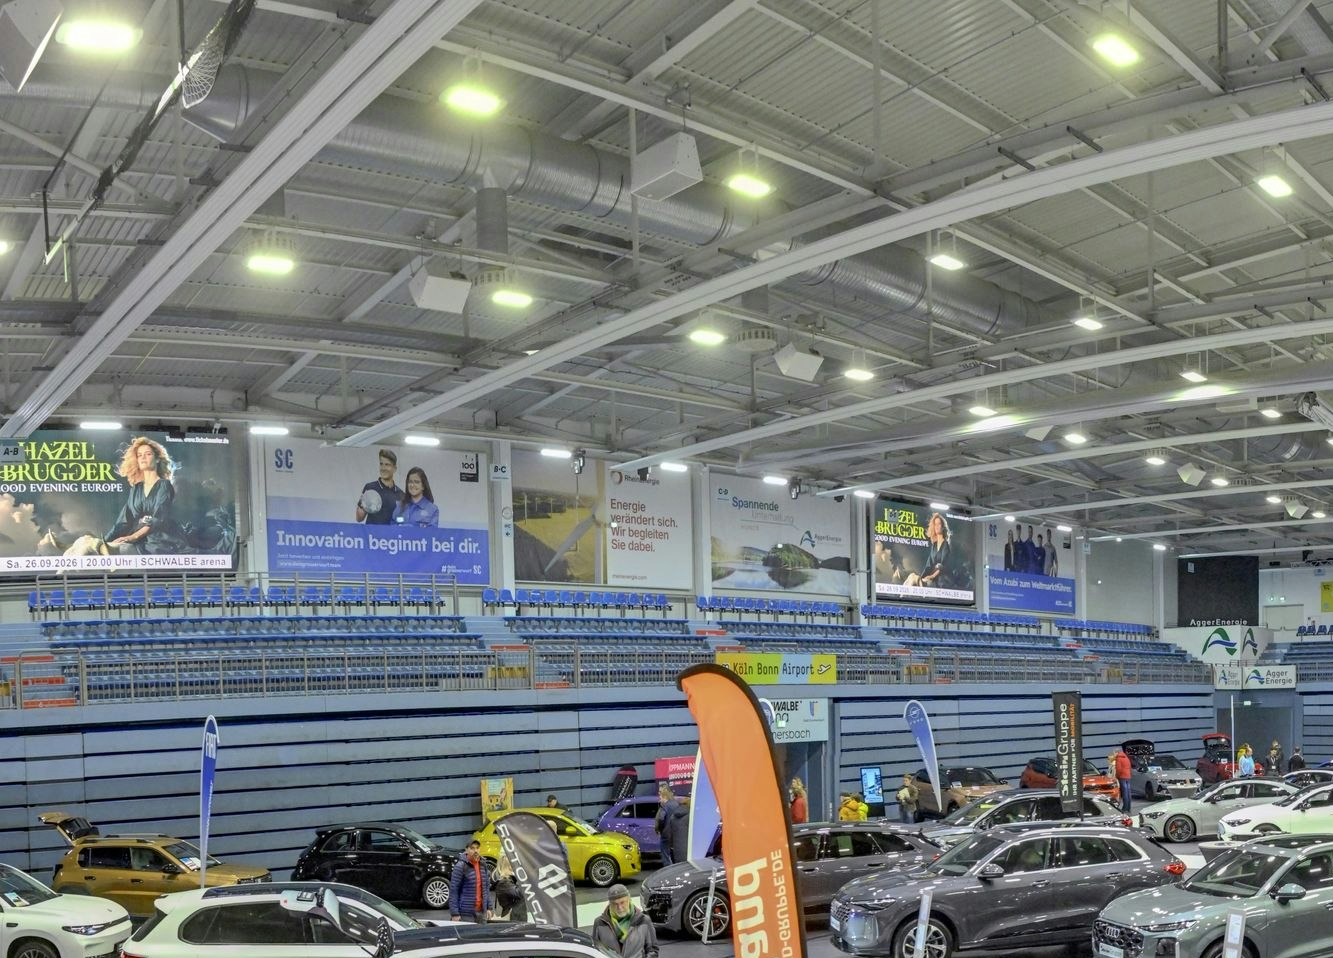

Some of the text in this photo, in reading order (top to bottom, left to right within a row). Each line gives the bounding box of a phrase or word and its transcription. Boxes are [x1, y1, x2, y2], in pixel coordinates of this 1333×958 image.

[3, 447, 19, 456] A-B
[18, 441, 95, 460] HAZEL
[0, 462, 116, 481] BRUGGER
[461, 461, 475, 470] 100
[494, 465, 507, 474] B-C
[624, 473, 660, 486] Rheinnergie
[0, 483, 123, 493] OOD EVENING EUROPE
[611, 498, 646, 513] Energie
[732, 496, 779, 513] Spannende
[611, 511, 678, 528] verändert sich.
[752, 510, 794, 524] Unterhaltung
[611, 526, 669, 542] Wir begleiten
[875, 521, 927, 540] BRUGGER
[276, 530, 481, 554] Innovation beginnt bei dir.
[611, 538, 655, 552] Sie dabei.
[911, 538, 929, 547] EUROPE
[7, 557, 226, 569] Sa. 26.09.2026 20.00 Uhr SCHWALBE arena
[990, 577, 1002, 586] Vom
[1003, 577, 1019, 588] Azubi
[1020, 581, 1031, 589] zum
[733, 662, 815, 677] Köln Bonn Airport
[771, 701, 799, 711] WALBE
[1058, 703, 1069, 797] SteinGruppe
